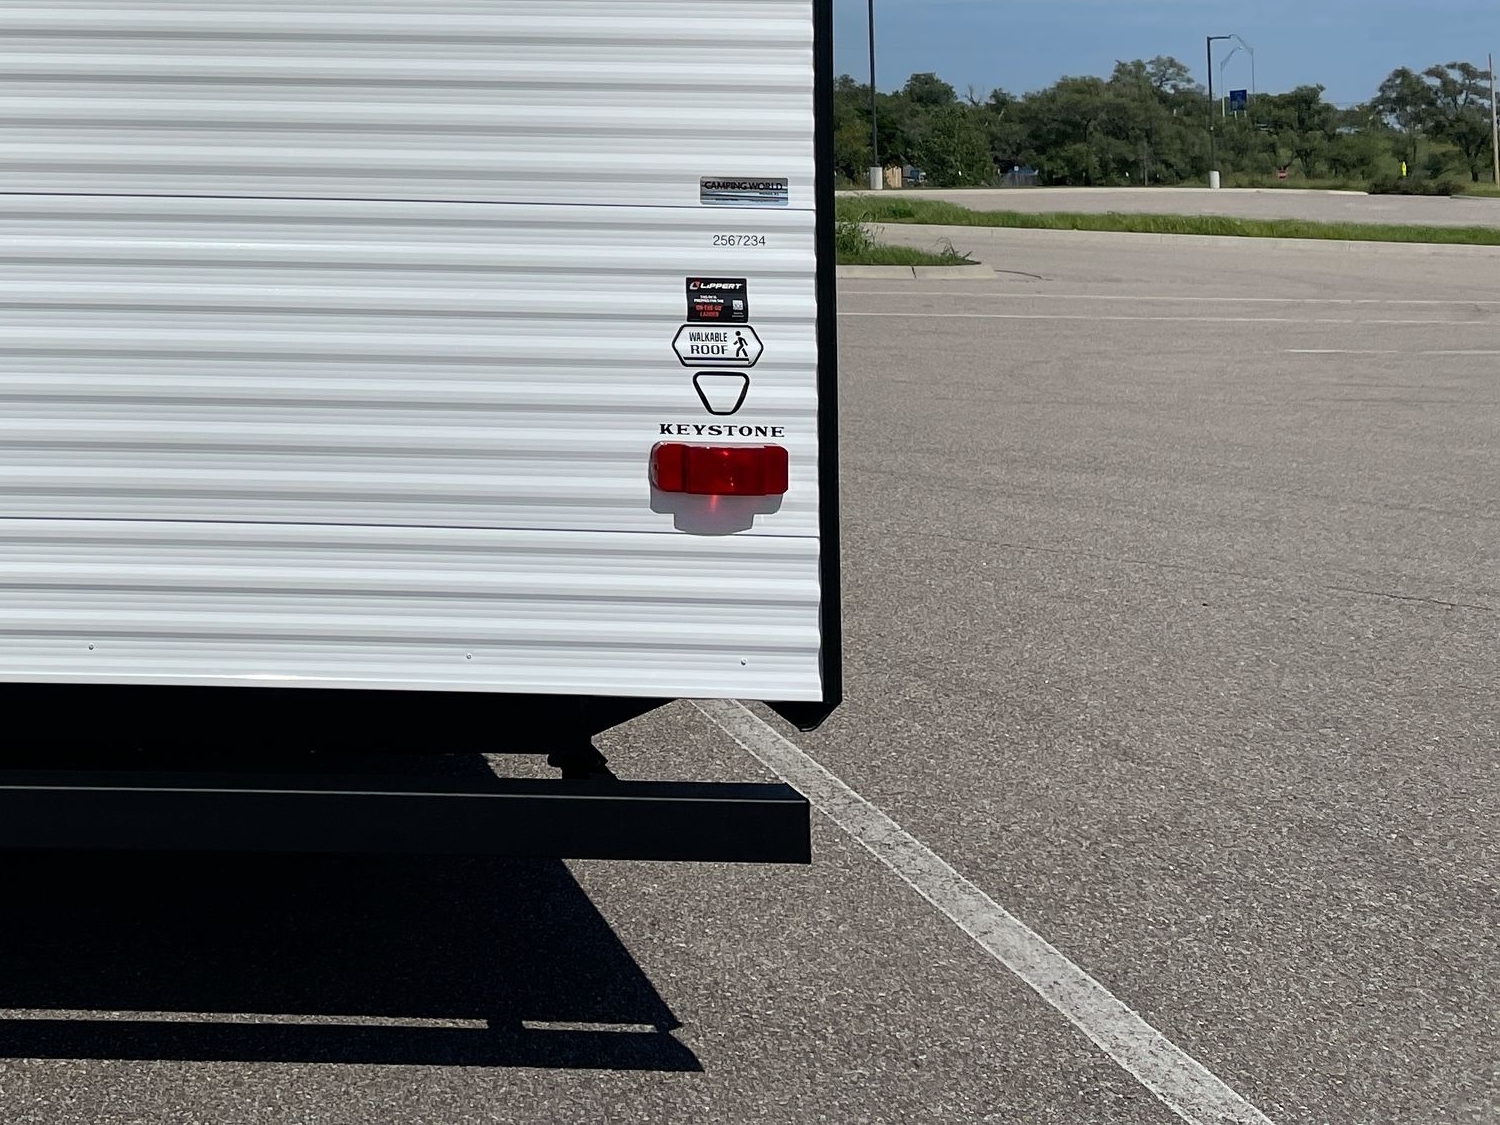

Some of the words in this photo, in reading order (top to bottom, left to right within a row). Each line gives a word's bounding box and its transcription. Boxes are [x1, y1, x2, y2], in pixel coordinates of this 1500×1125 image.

[704, 181, 747, 190] CAMPING
[749, 182, 783, 191] WORLD
[713, 234, 766, 246] 2567234
[689, 332, 728, 342] WALKABLE
[690, 344, 728, 355] ROOF
[659, 423, 785, 437] KEYSTONE
